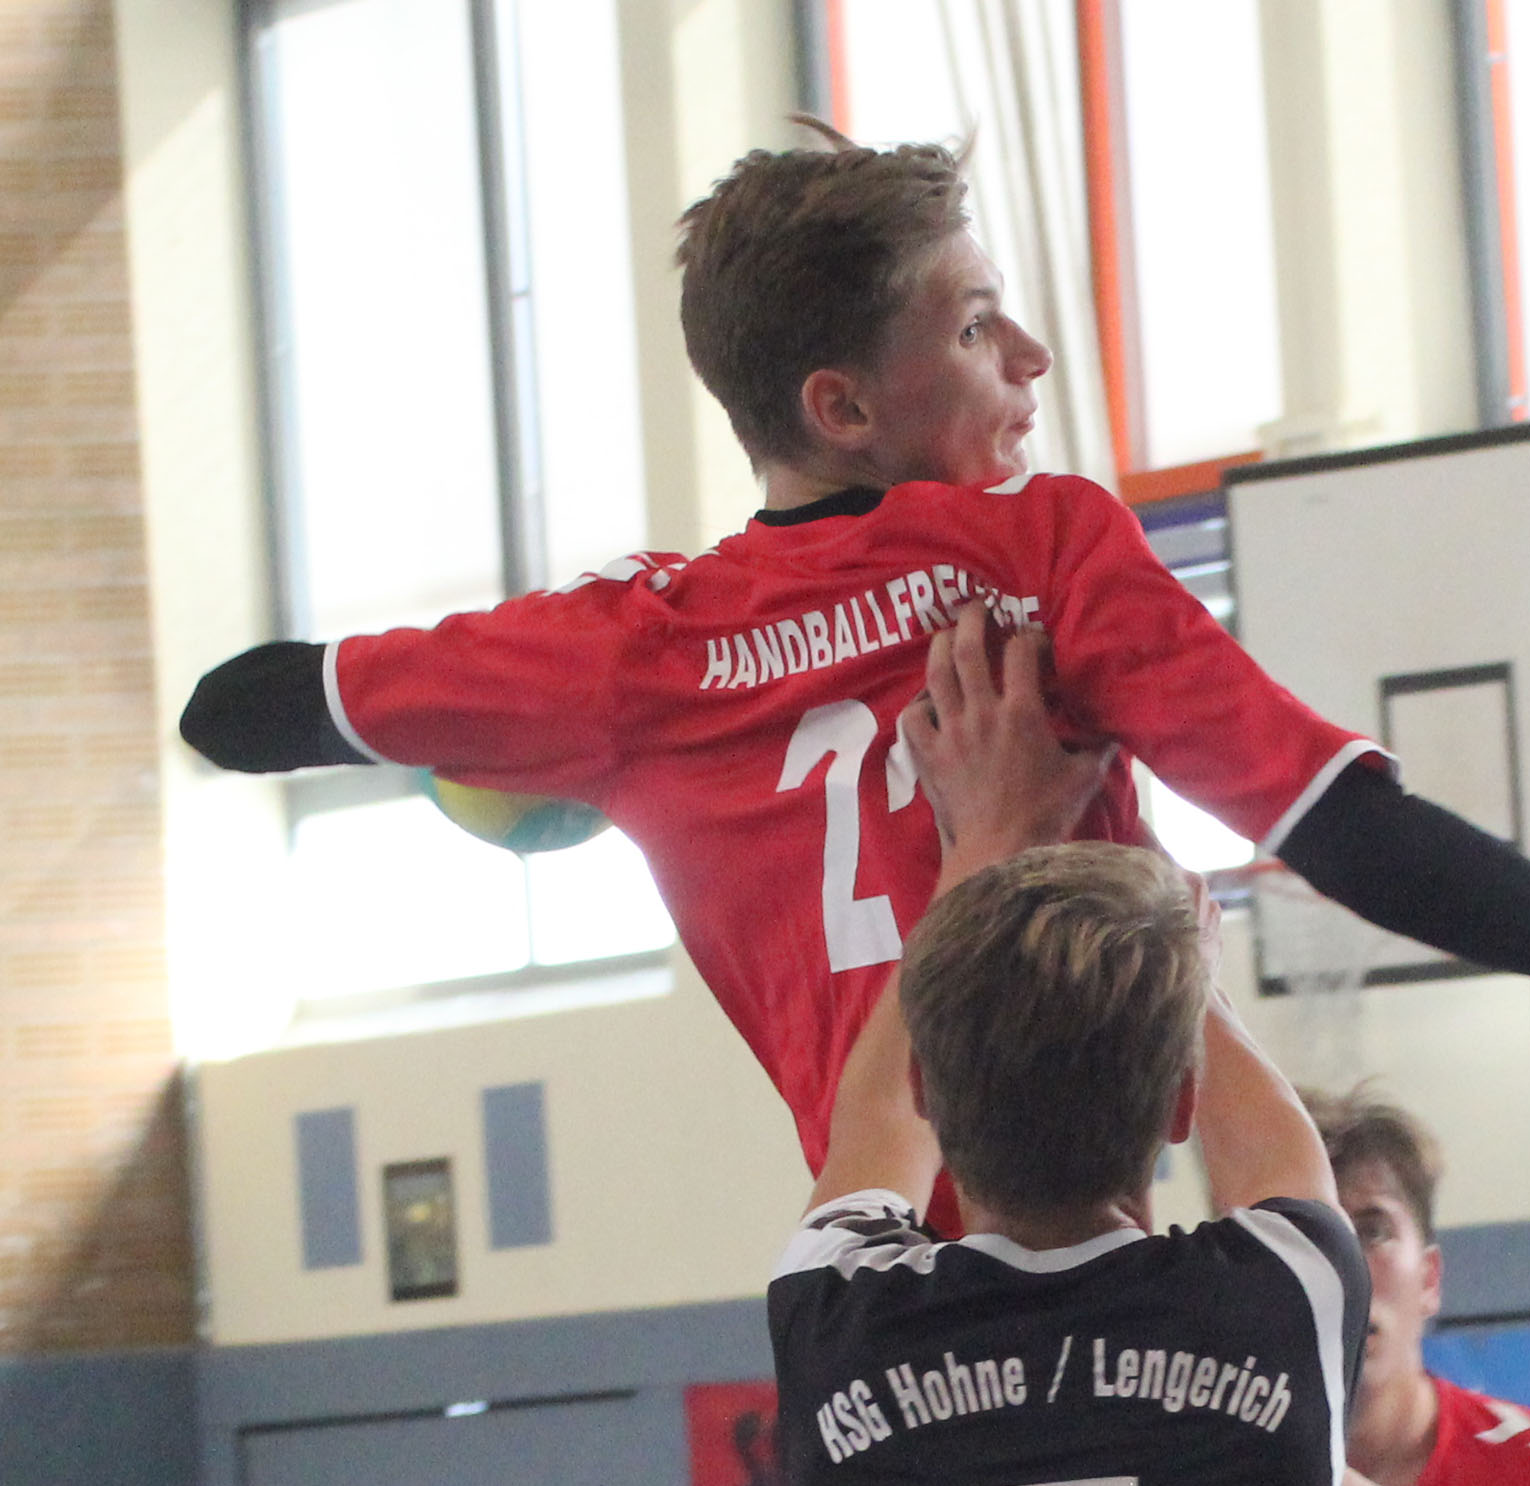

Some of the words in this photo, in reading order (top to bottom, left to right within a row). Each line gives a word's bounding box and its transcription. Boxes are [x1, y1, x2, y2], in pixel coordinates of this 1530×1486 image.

[816, 1378, 893, 1464] HSG
[886, 1352, 1027, 1428] Hohne
[1047, 1335, 1073, 1403] /
[1092, 1338, 1292, 1432] Lengerich
